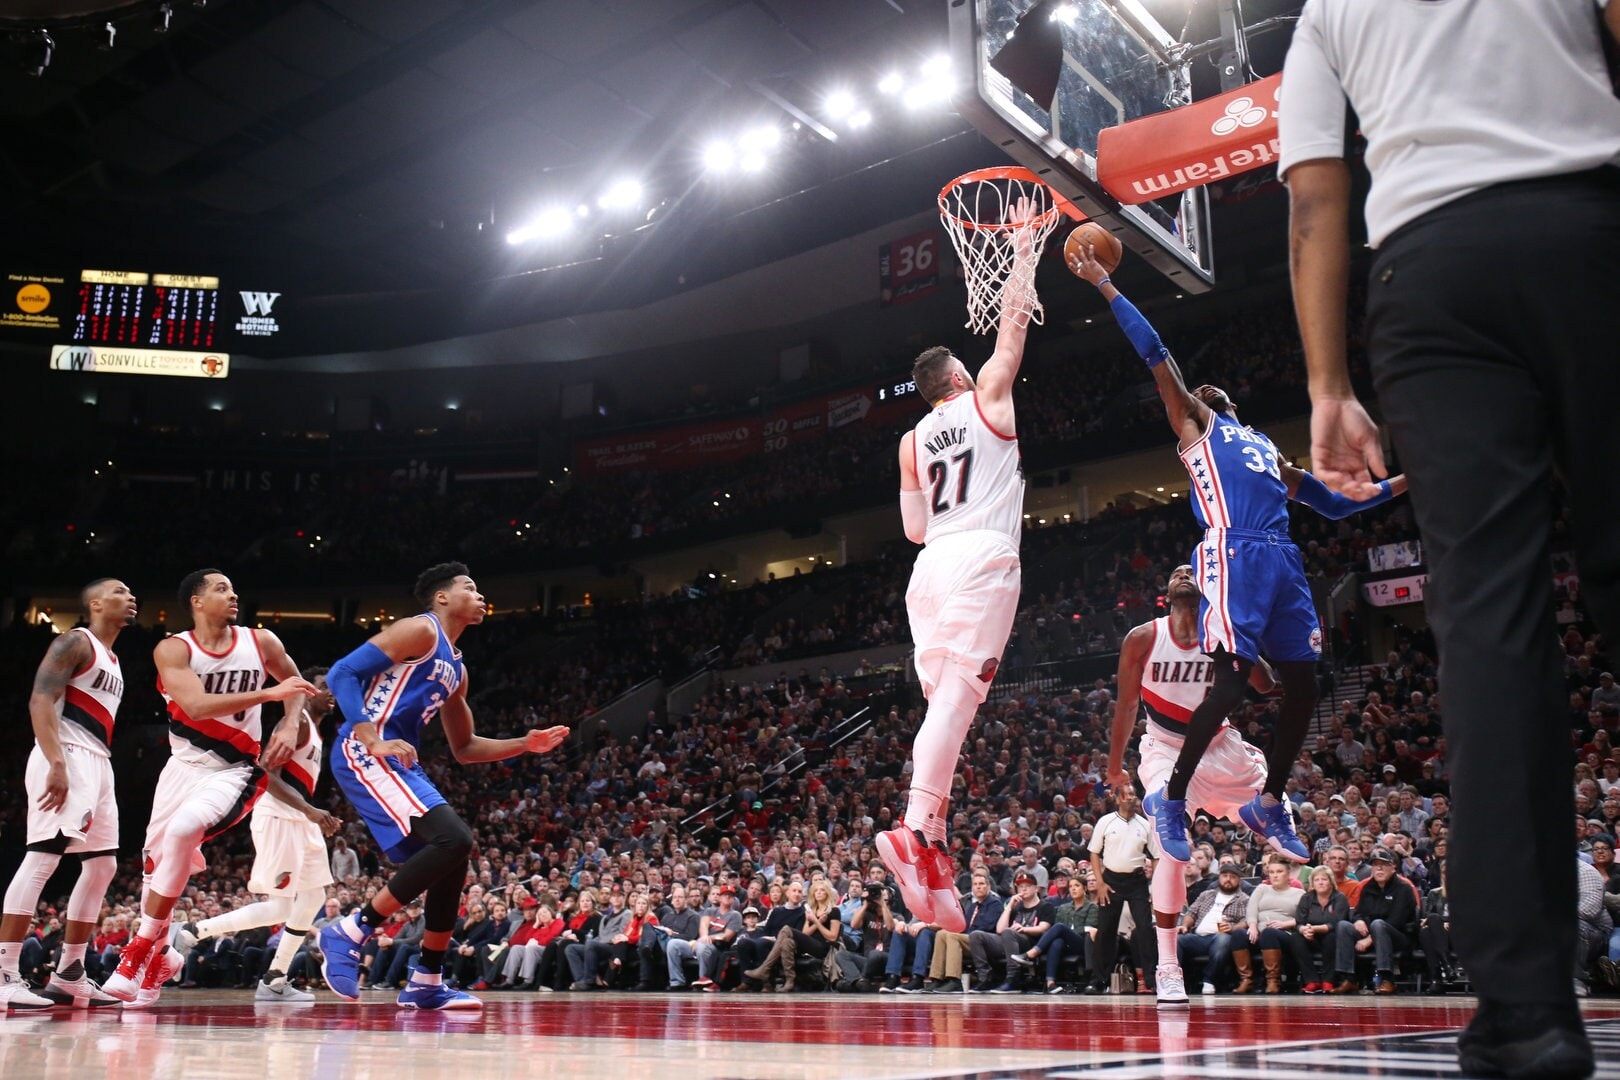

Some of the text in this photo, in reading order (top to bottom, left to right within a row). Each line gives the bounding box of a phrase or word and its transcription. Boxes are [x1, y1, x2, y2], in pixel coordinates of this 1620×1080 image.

[896, 239, 933, 277] 36
[235, 323, 279, 332] BROTHERS
[70, 351, 157, 372] WILSONVILLE
[689, 430, 736, 446] SAFEWAY
[204, 468, 272, 491] THIS
[294, 471, 321, 493] IS
[928, 447, 974, 516] 27
